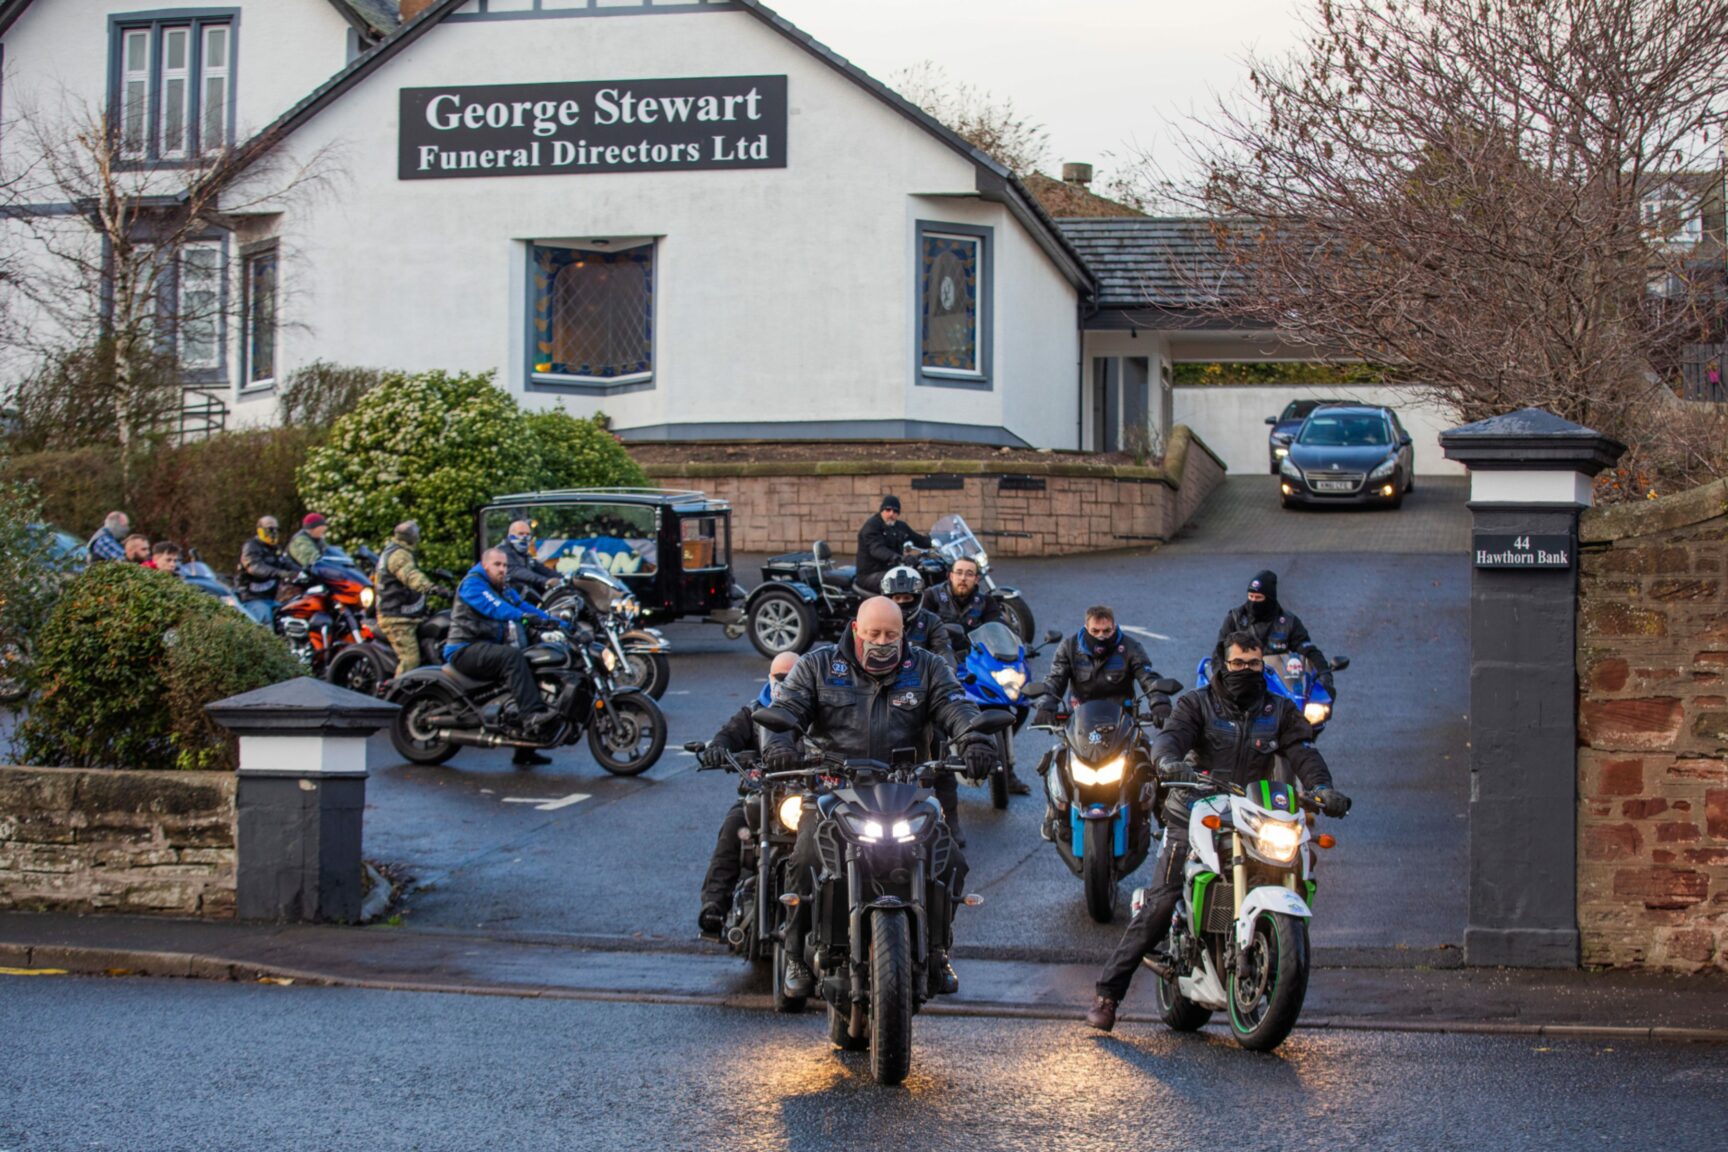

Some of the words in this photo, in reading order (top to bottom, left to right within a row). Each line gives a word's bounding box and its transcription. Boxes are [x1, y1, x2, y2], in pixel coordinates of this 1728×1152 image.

[425, 94, 580, 136] George
[594, 87, 762, 125] Stewart
[416, 142, 540, 171] Funeral
[551, 139, 701, 166] Directors
[711, 135, 769, 161] Ltd
[1513, 536, 1530, 549] 44
[1476, 550, 1534, 564] Hawthorn
[1537, 550, 1568, 564] Bank
